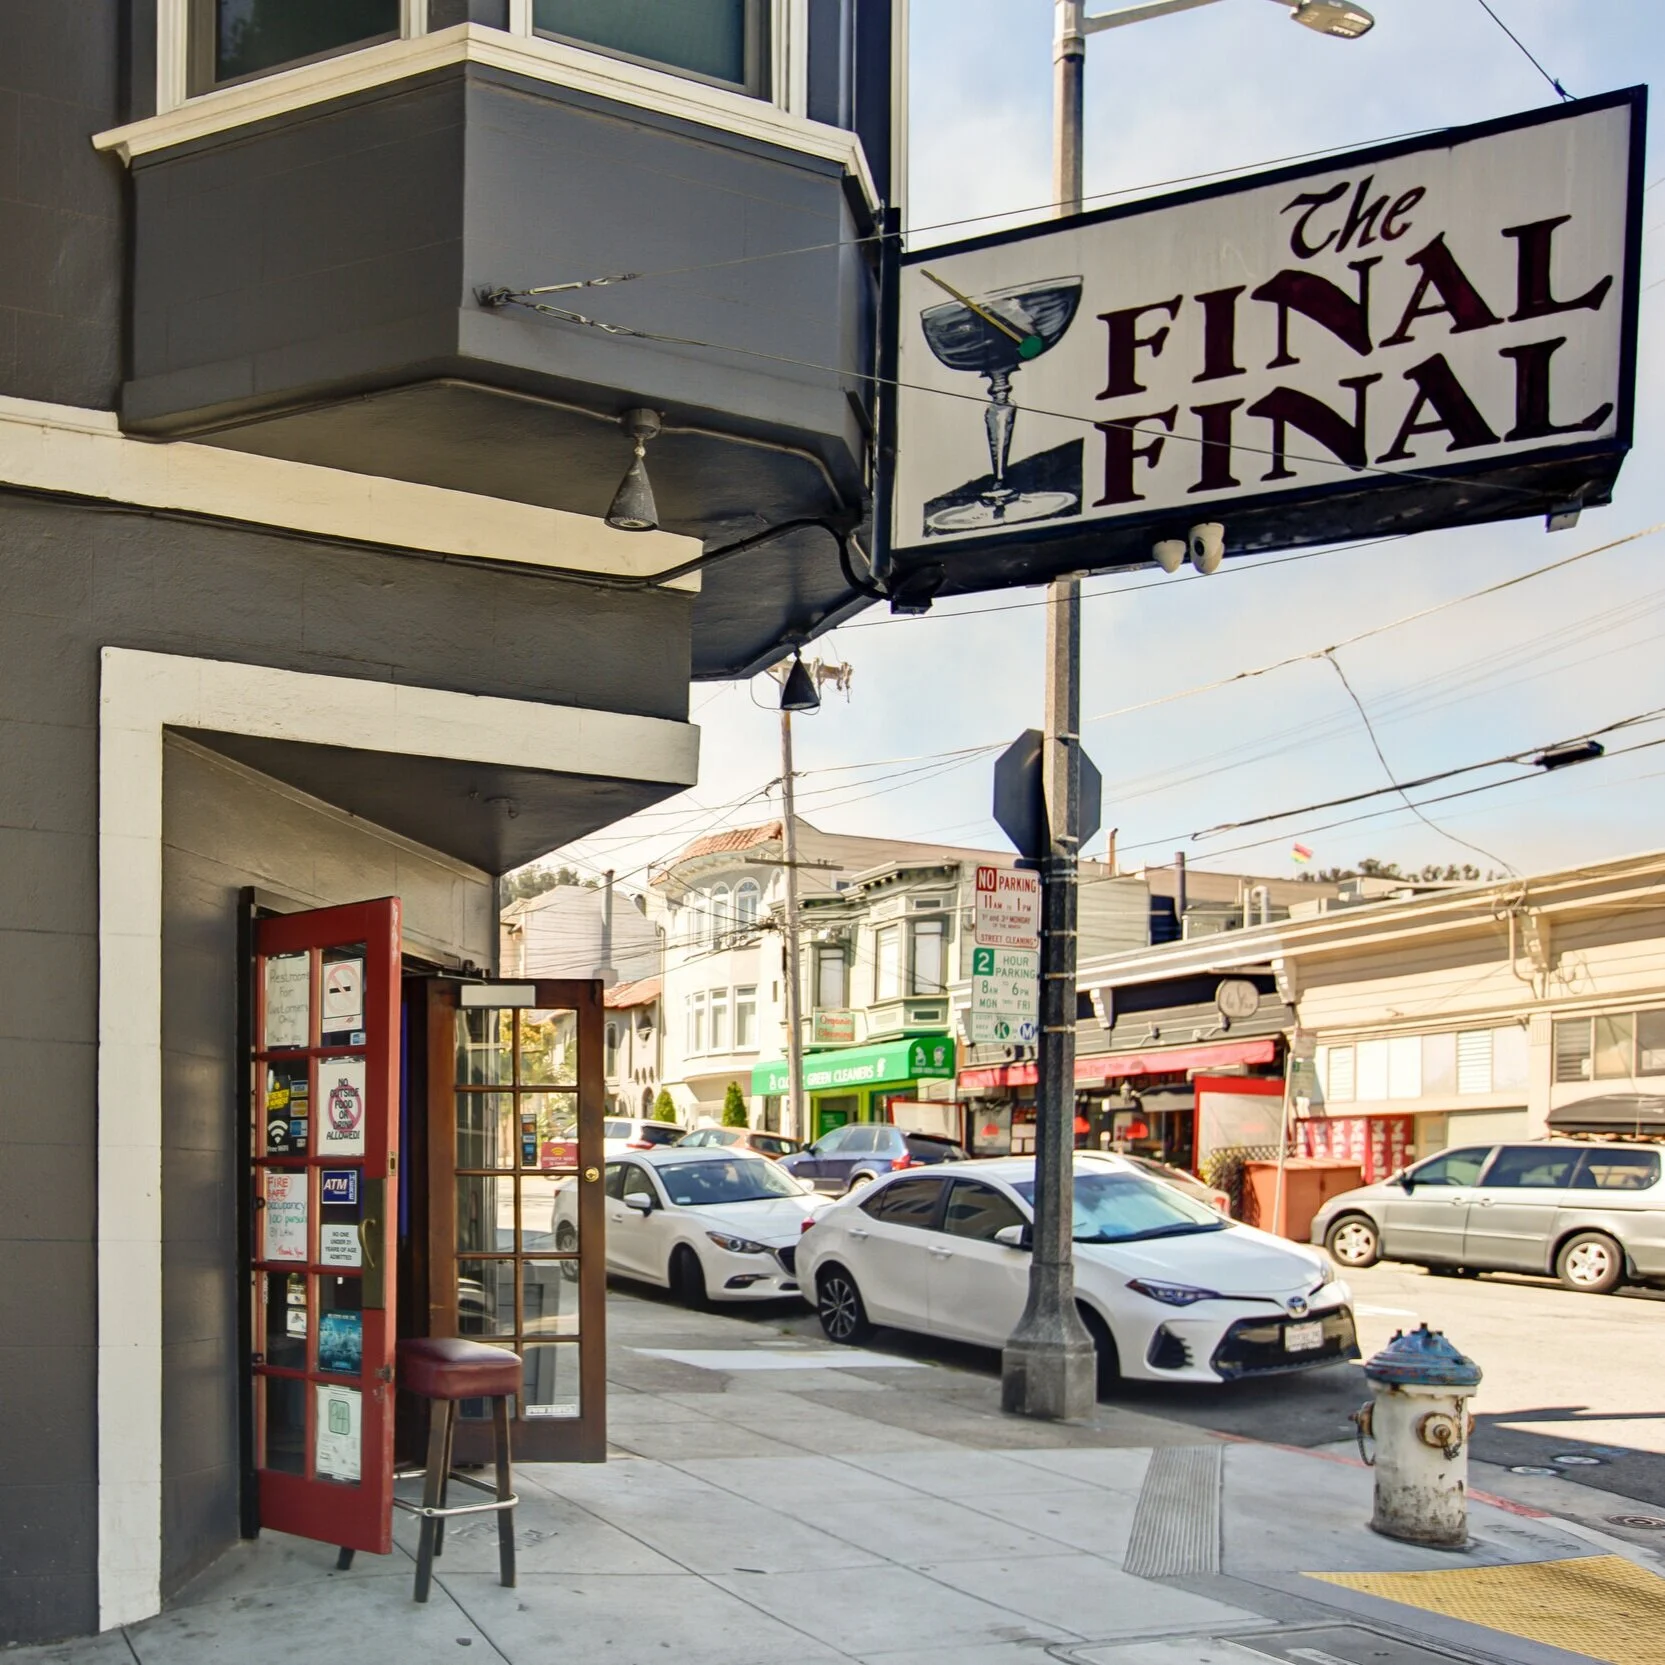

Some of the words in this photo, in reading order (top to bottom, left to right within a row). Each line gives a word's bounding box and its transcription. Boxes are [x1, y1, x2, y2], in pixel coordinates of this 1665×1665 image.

[1281, 174, 1427, 260] The
[1095, 213, 1613, 401] FINAL
[1092, 335, 1614, 508] FINAL
[978, 869, 996, 890] NO
[999, 875, 1037, 893] PARKING
[980, 934, 1003, 943] STREET
[978, 951, 990, 972] 2
[1003, 956, 1029, 966] HOUR
[996, 967, 1036, 980] PARKING
[979, 998, 998, 1009] MON
[1017, 1000, 1031, 1010] FRI
[807, 1071, 832, 1086] GREEN
[833, 1065, 875, 1083] CLEANERS
[338, 1078, 349, 1087] NO
[330, 1087, 360, 1098] OUTSIDE
[334, 1100, 354, 1109] FOOD
[338, 1110, 349, 1119] OR
[333, 1120, 354, 1130] DRINK
[326, 1131, 361, 1140] ALLOWED!
[267, 1177, 289, 1188] FIRE
[324, 1178, 349, 1191] ATM
